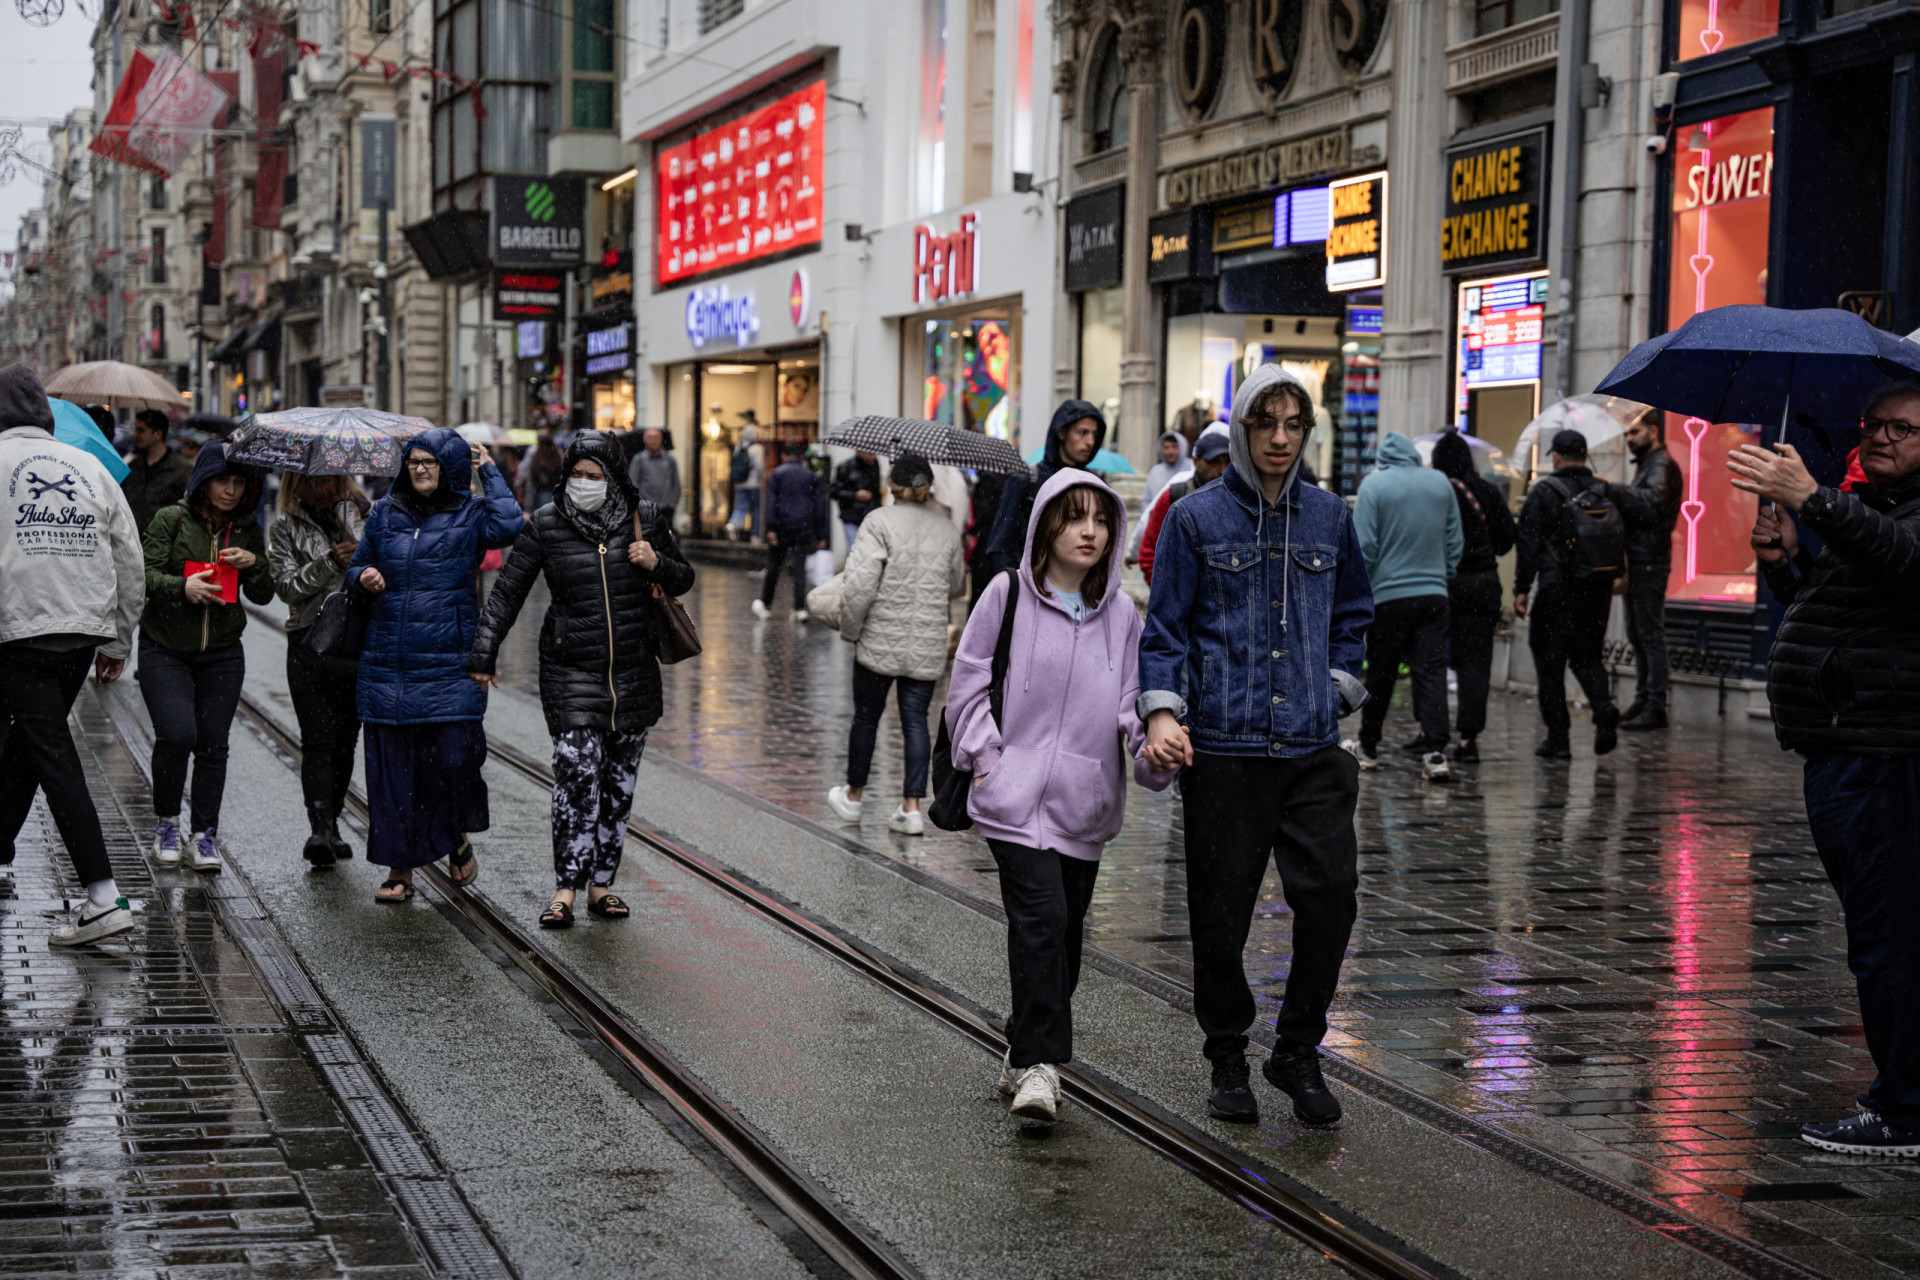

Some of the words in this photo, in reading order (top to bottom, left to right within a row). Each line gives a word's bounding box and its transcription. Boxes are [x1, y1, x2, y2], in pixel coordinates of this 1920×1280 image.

[1452, 146, 1521, 204] CHANGE
[1333, 181, 1372, 219] CHANGE
[500, 226, 581, 250] BARGELLO
[1441, 203, 1529, 261] EXCHANGE
[59, 461, 80, 476] AUTO
[15, 503, 55, 525] Auto
[56, 506, 96, 530] Shop
[16, 530, 98, 539] PROFESSIONAL
[18, 537, 41, 545] CAR
[48, 538, 99, 547] SERVICES
